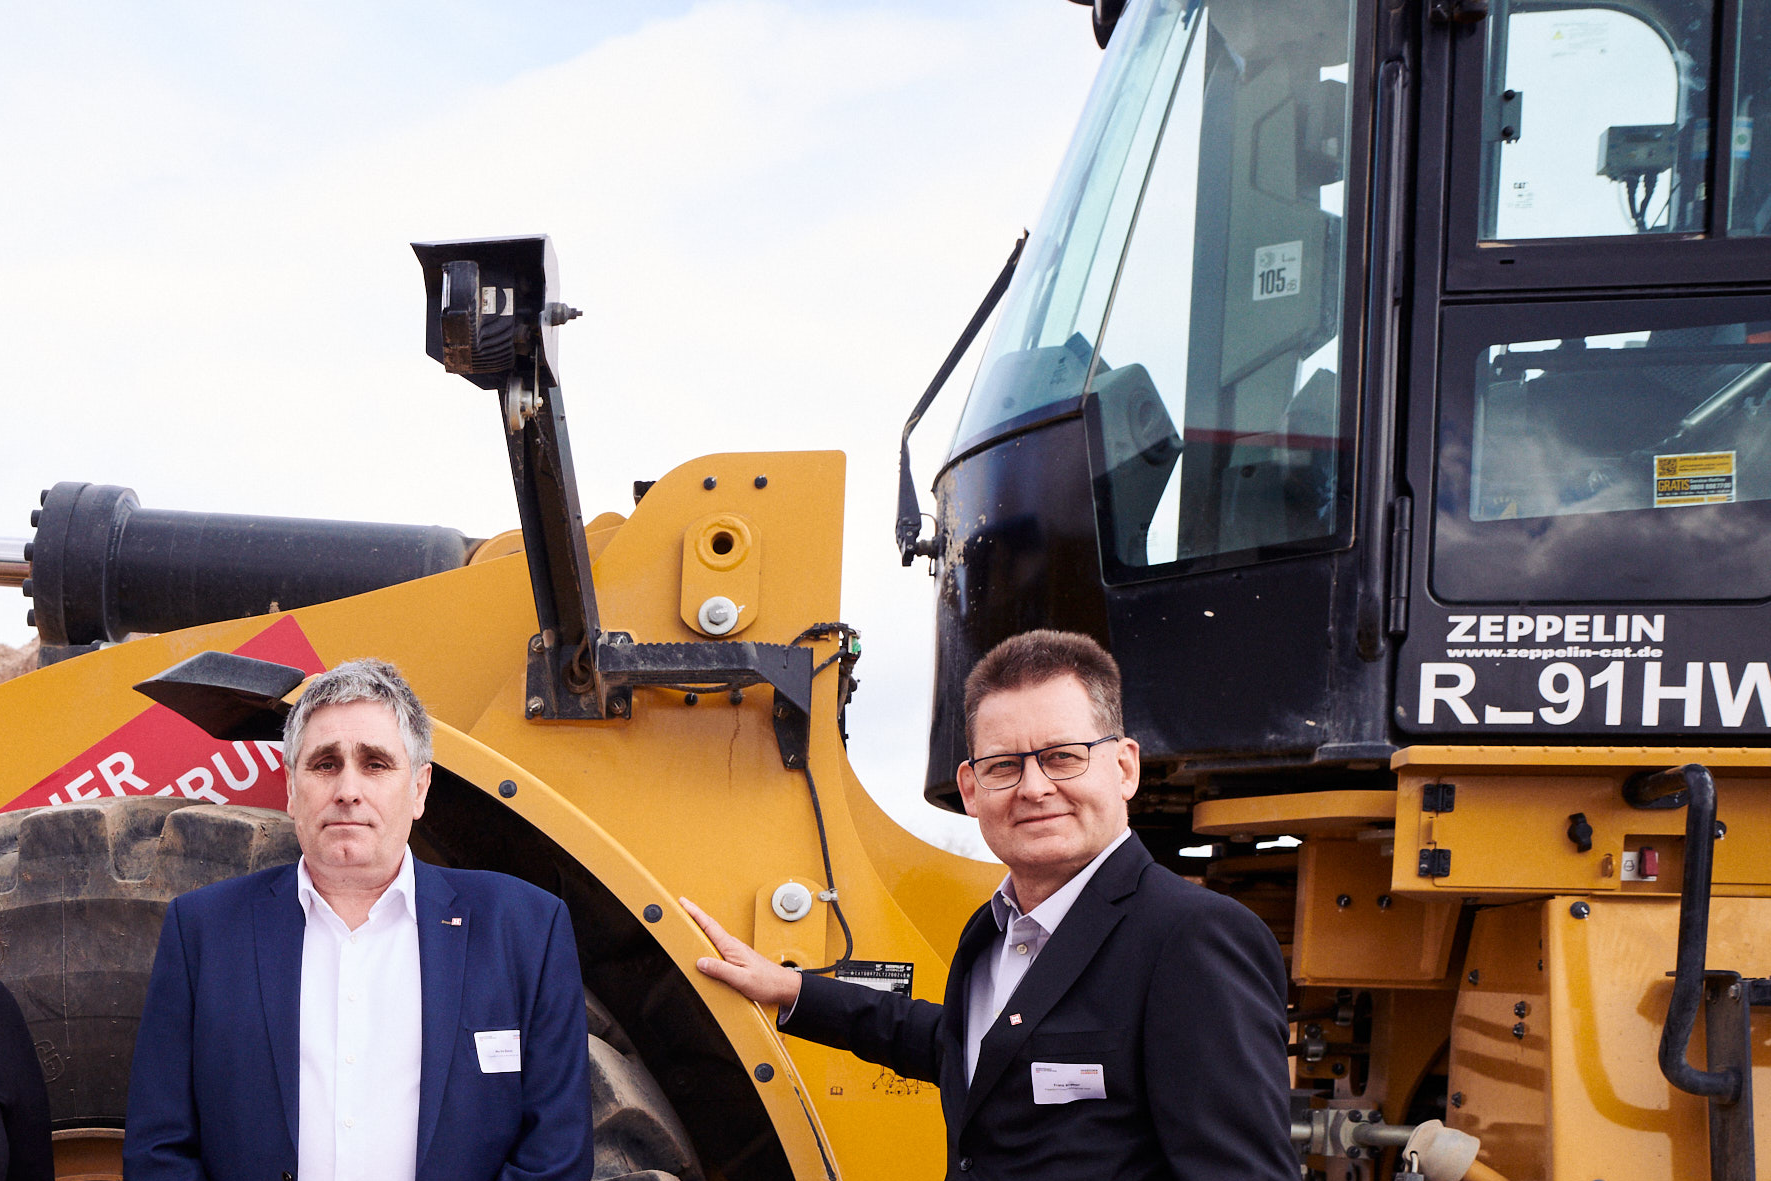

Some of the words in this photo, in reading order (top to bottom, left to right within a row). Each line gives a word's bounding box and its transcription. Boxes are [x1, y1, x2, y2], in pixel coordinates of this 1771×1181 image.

[1258, 267, 1286, 295] 105
[1658, 479, 1690, 491] GRATIS
[1446, 614, 1665, 642] ZEPPELIN
[1446, 646, 1664, 660] www.zeppelin-cat.de
